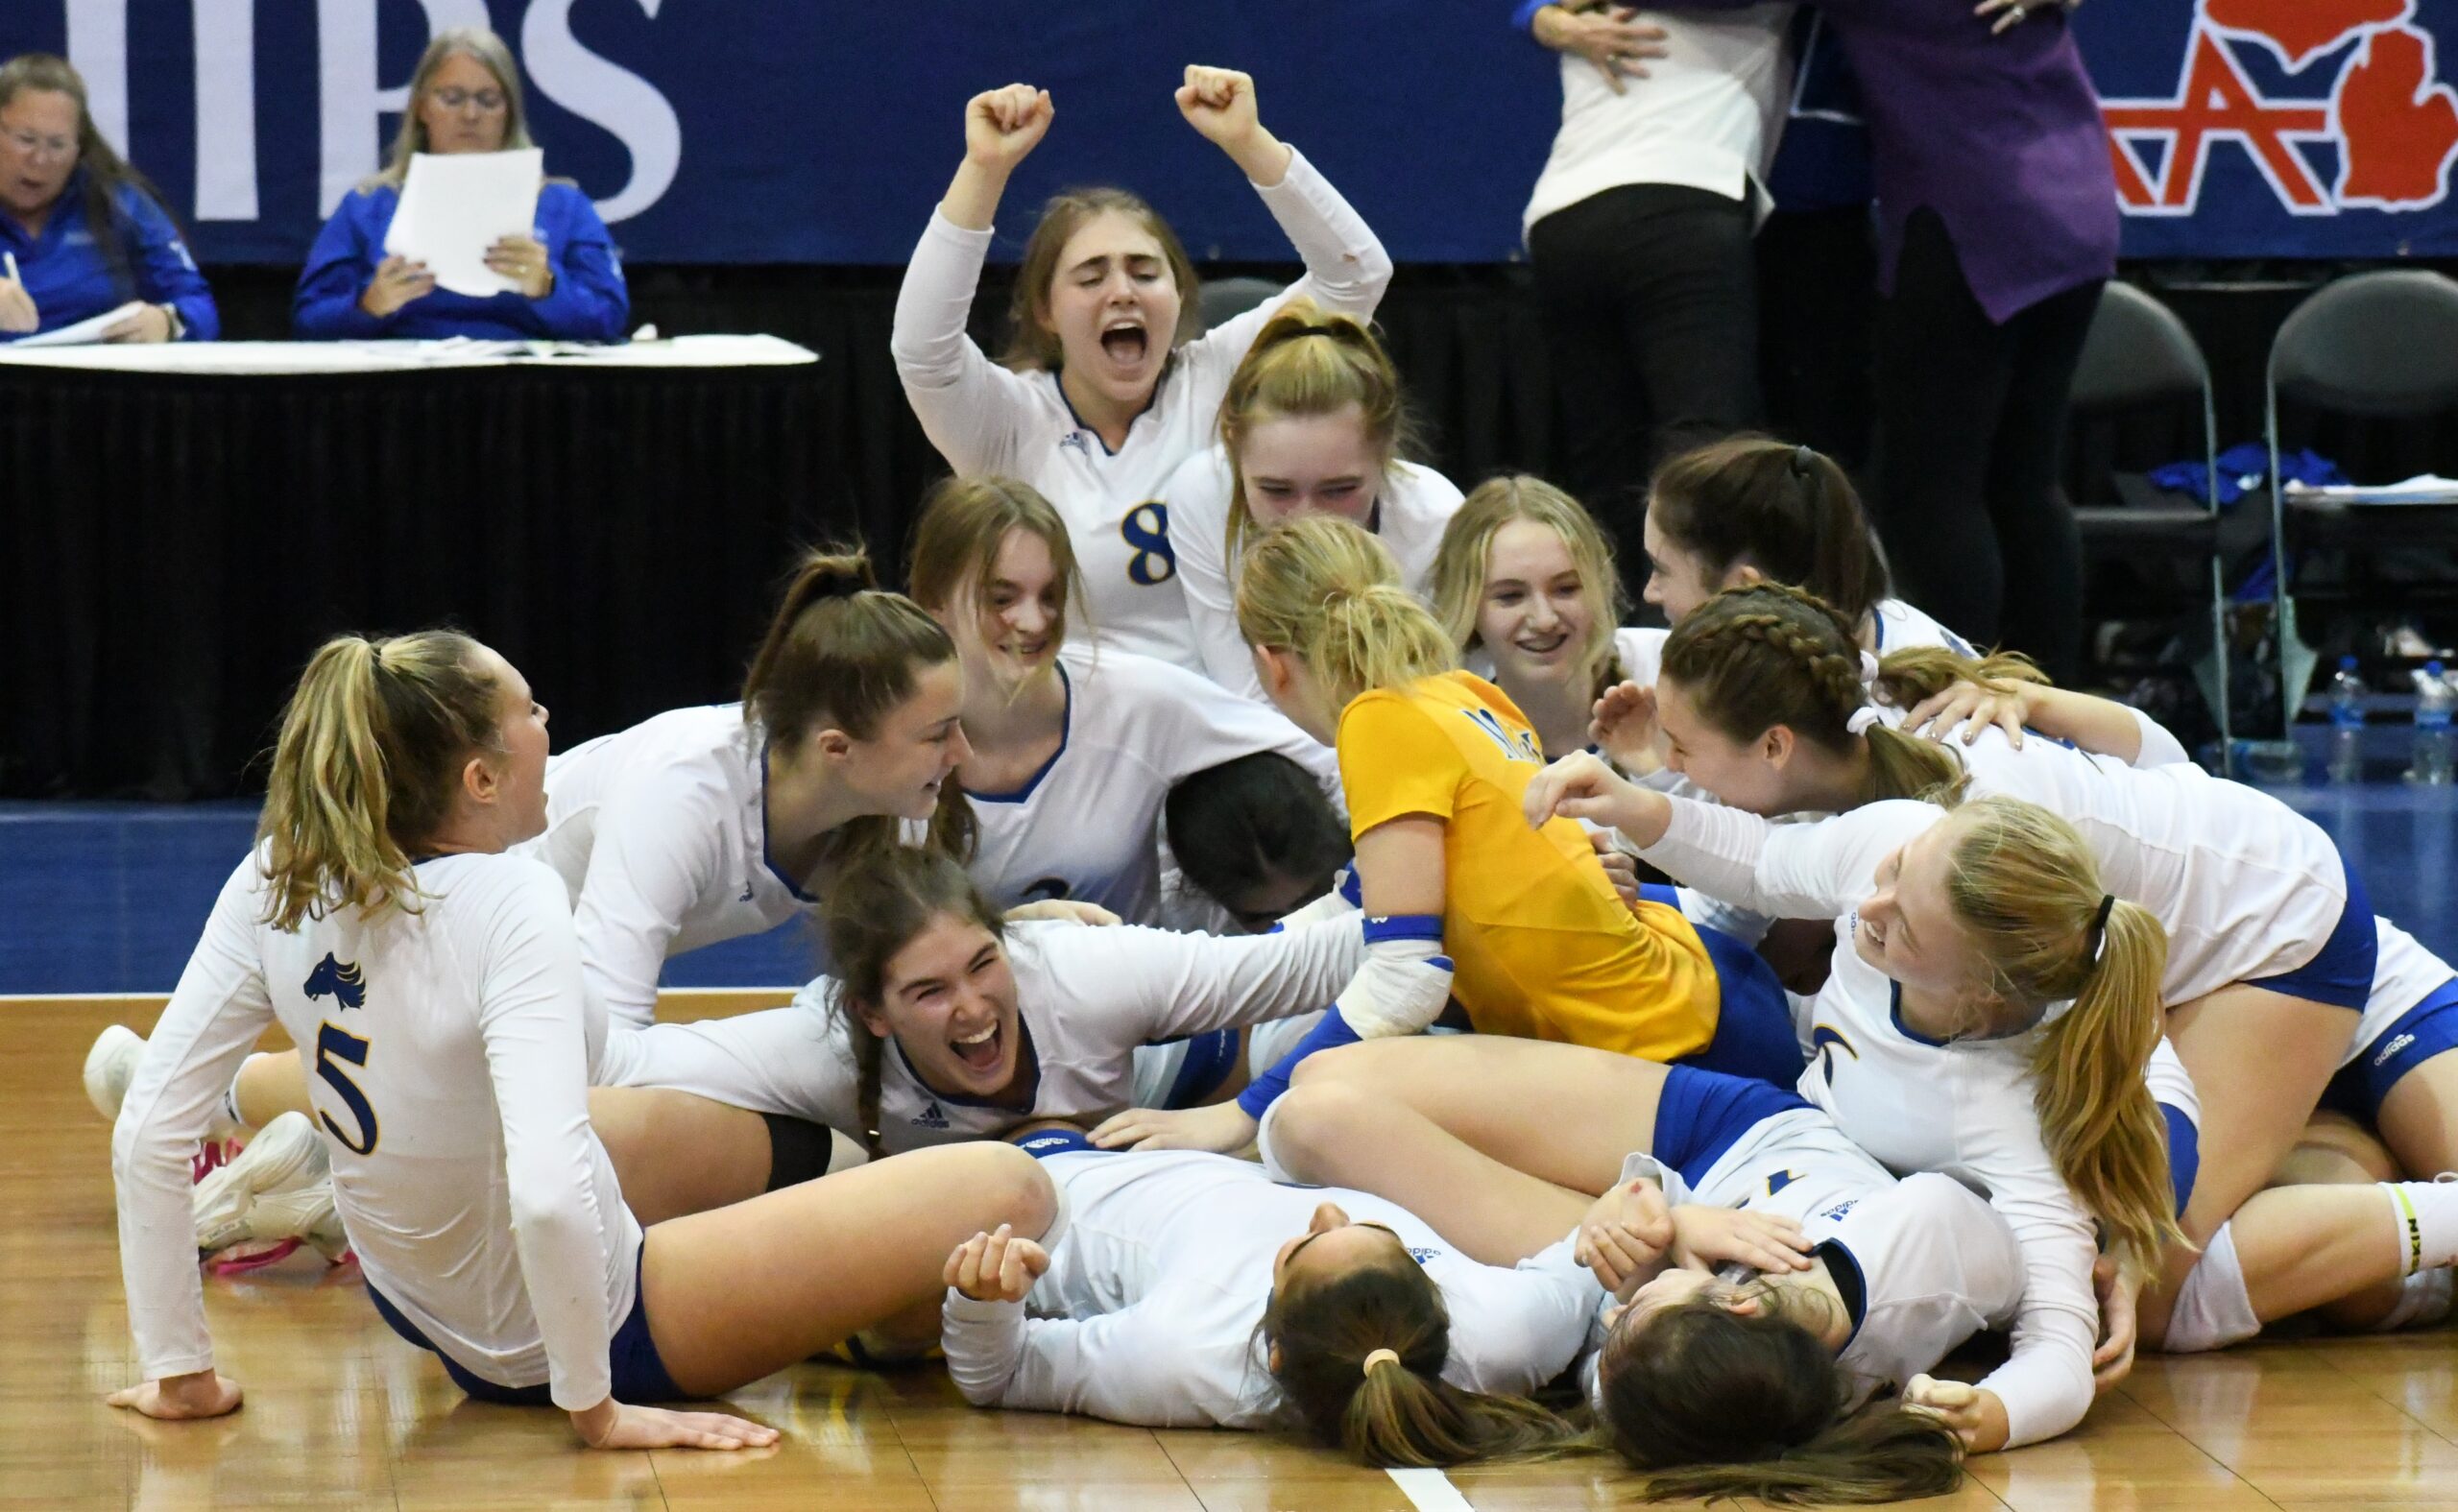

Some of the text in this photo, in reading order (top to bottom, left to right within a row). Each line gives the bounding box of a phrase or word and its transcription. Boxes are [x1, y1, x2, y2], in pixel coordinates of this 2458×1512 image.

[1120, 499, 1177, 586] 8
[316, 1018, 381, 1157] 5
[2374, 1033, 2416, 1067] adidas
